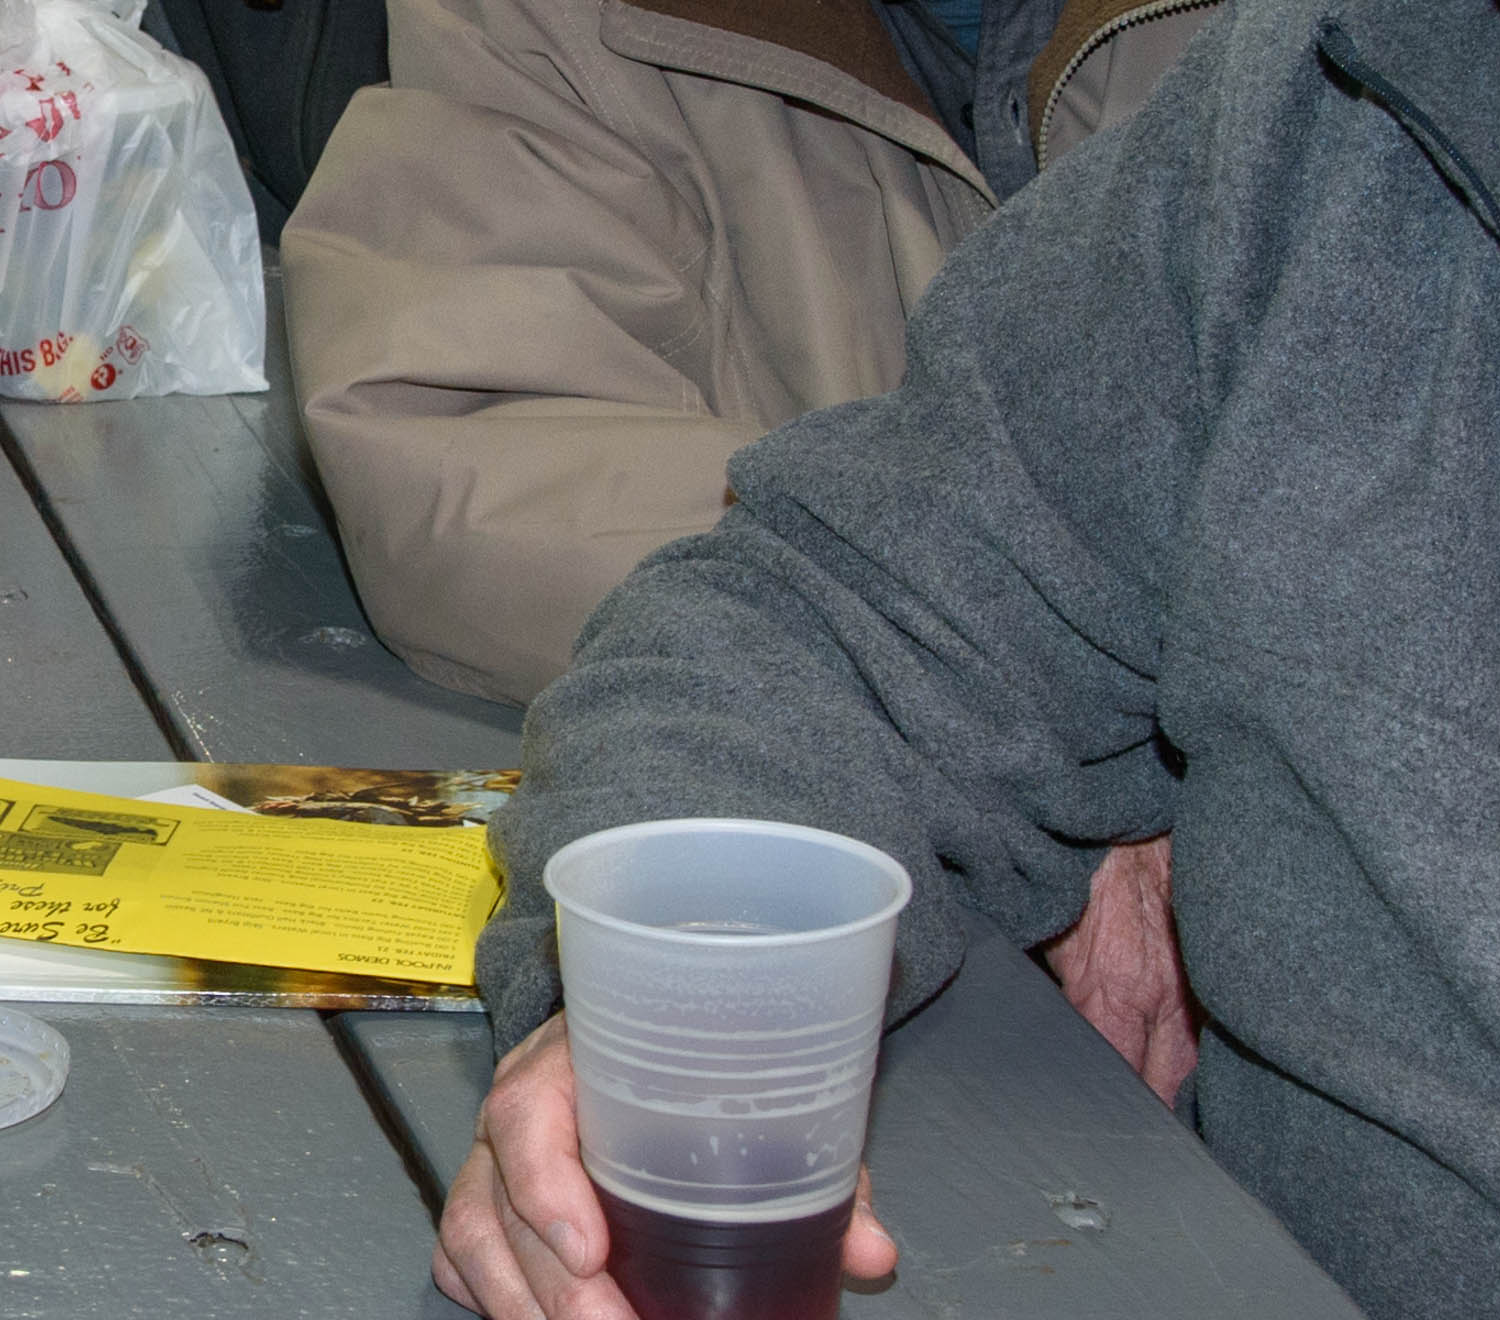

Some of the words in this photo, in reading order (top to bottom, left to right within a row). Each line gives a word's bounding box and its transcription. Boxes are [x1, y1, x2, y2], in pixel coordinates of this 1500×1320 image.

[10, 900, 72, 918] these
[82, 898, 120, 918] for
[0, 922, 64, 941] Sure
[338, 952, 390, 965] DEMOS
